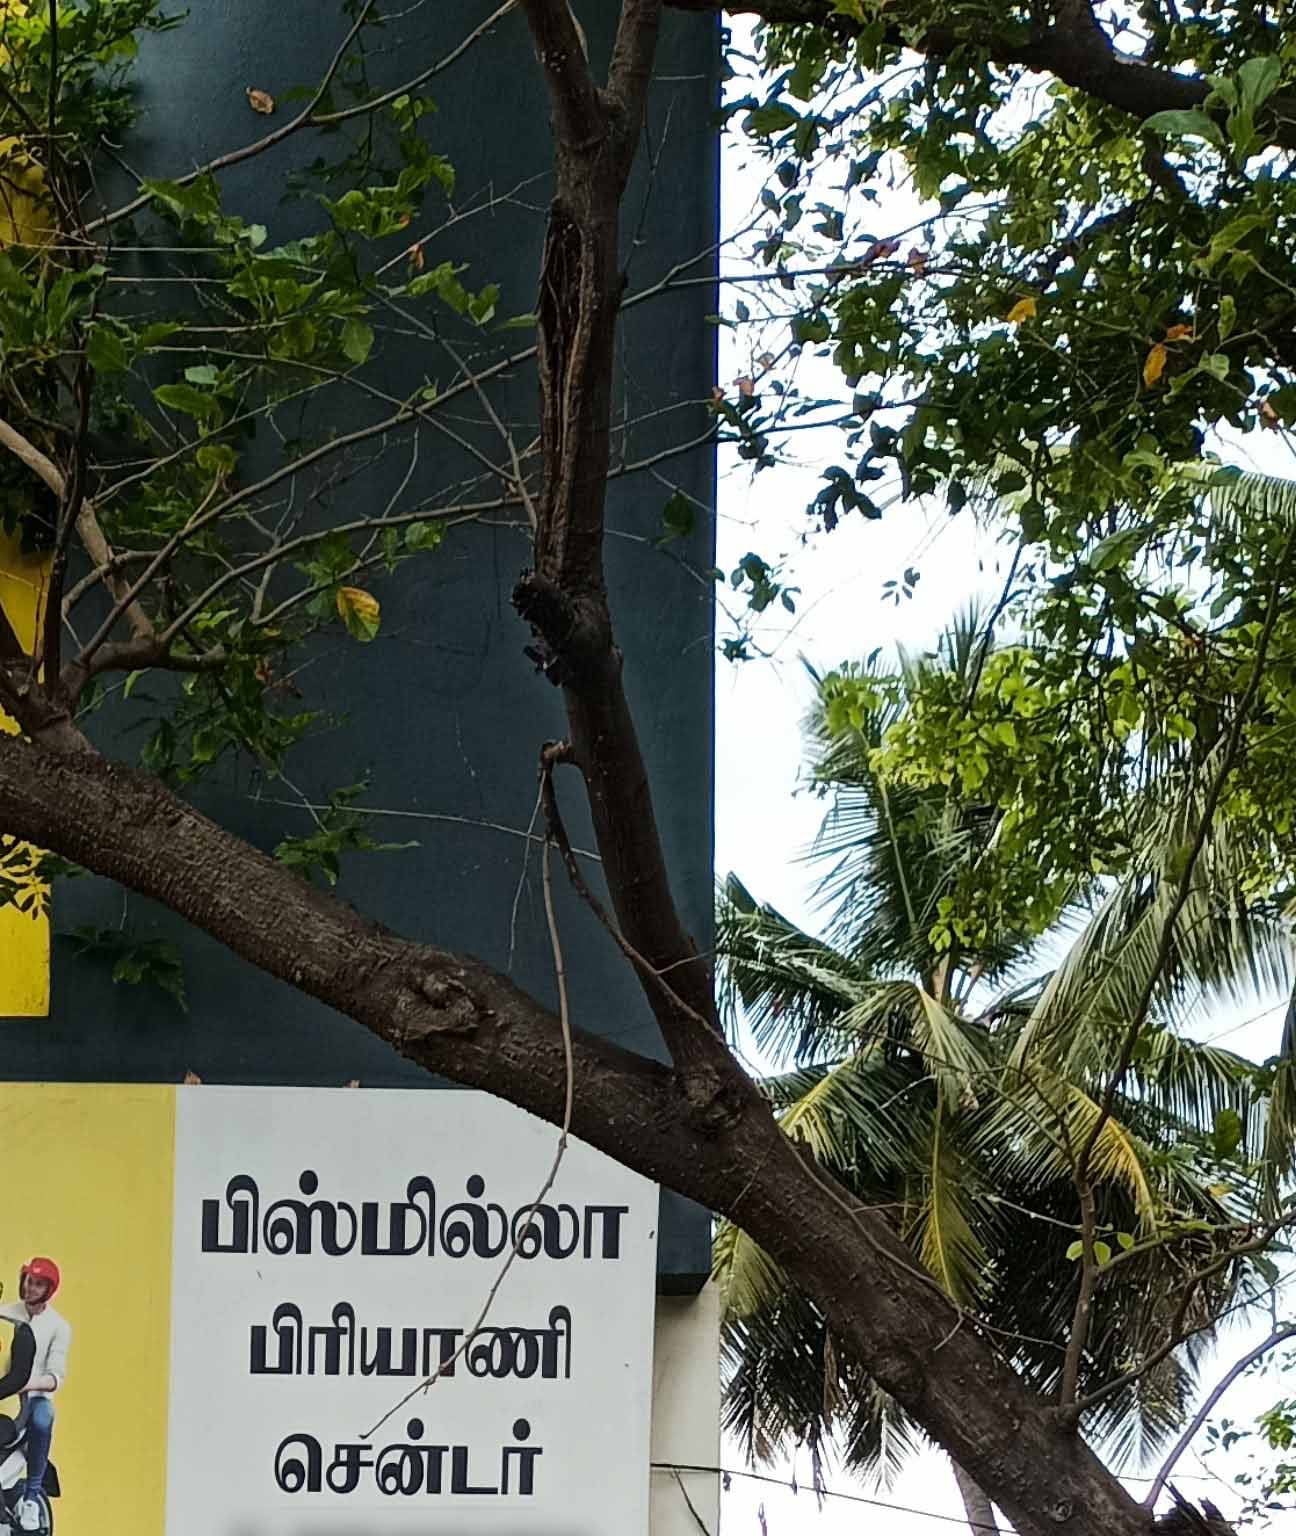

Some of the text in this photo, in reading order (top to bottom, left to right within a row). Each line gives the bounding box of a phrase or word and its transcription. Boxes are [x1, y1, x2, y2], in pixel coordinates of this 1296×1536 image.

[201, 1169, 629, 1260] பிஸ்மில்லா
[250, 1301, 572, 1379] பிரியாணி
[274, 1418, 544, 1497] சென்டர்
